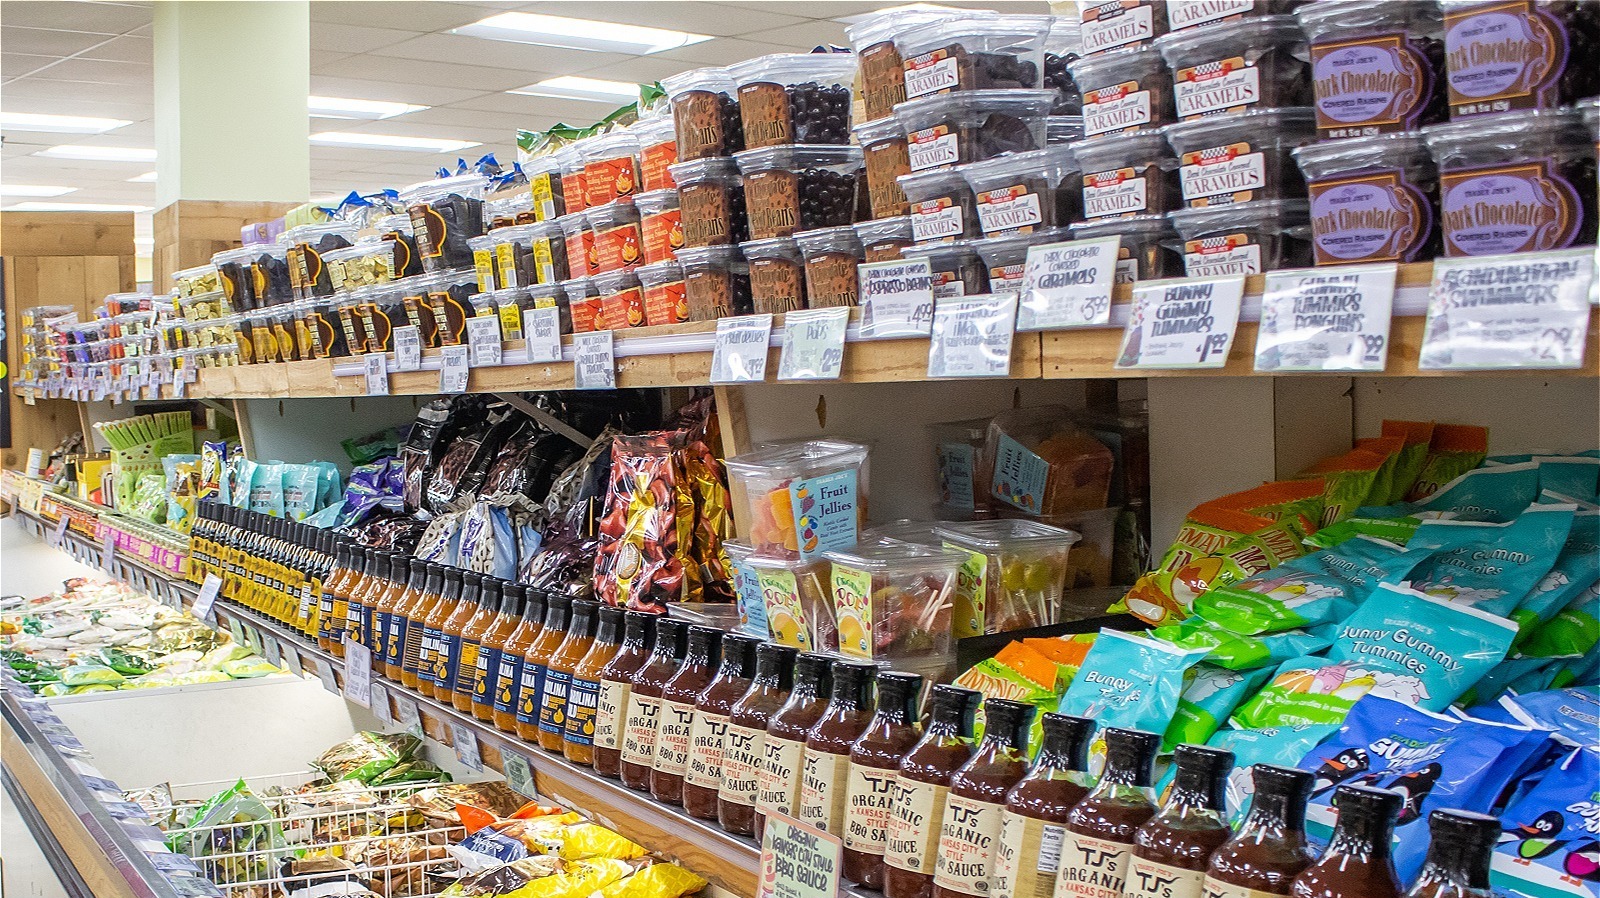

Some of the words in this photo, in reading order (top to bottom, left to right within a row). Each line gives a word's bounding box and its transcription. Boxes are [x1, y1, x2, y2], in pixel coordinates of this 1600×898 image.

[1172, 0, 1249, 25] CARAMELS
[1084, 21, 1148, 49] CARAMELS
[1470, 38, 1530, 67] Chocolate
[909, 69, 954, 95] CARAMELS
[1341, 69, 1399, 94] Chocolate
[1453, 73, 1485, 84] COVERED
[1486, 67, 1518, 76] RAISINS
[1178, 85, 1253, 113] CARAMELS
[1323, 100, 1356, 110] COVERED
[1357, 96, 1387, 106] RAISINS
[1085, 106, 1145, 133] CARAMELS
[1184, 169, 1259, 195] CARAMELS
[982, 208, 1037, 230] CARAMELS
[1339, 206, 1400, 231] Chocolate
[1475, 201, 1542, 227] Chocolate
[915, 219, 959, 238] CARAMELS
[1455, 231, 1491, 241] COVERED
[1492, 228, 1528, 238] RAISINS
[1322, 236, 1355, 246] COVERED
[1356, 233, 1385, 242] RAISINS
[1049, 259, 1080, 272] COVERED
[1038, 268, 1097, 289] CARAMELS
[1165, 284, 1214, 301] BUNNY
[1156, 300, 1212, 320] GUMMY
[1292, 293, 1362, 314] TUMMIES
[1150, 317, 1214, 337] TUMMIES
[1001, 448, 1013, 475] Fruit
[1011, 450, 1023, 482] Jellies
[820, 484, 848, 500] Fruit
[819, 502, 852, 518] Jellies
[1321, 554, 1359, 572] Bunny
[1472, 548, 1534, 566] Gummy
[1410, 622, 1436, 635] JOE'S
[1351, 641, 1427, 674] Tummies
[1392, 628, 1463, 673] Gummy
[1085, 670, 1134, 691] Bunny
[599, 701, 616, 715] ANIC
[629, 716, 658, 729] ORGA
[662, 724, 690, 736] ORGA
[631, 728, 651, 737] KANSAS
[637, 736, 653, 744] STYLE
[665, 736, 688, 744] KANSAS
[625, 738, 638, 751] BBQ
[694, 736, 723, 748] ORGA
[658, 746, 673, 761] BBQ
[698, 748, 720, 757] KANSAS
[725, 749, 762, 768] GANIC
[691, 759, 705, 774] BBQ
[705, 757, 723, 767] STYLE
[737, 763, 752, 772] CITY
[762, 761, 791, 779] ANIC
[726, 769, 740, 779] STYLE
[727, 779, 758, 792] SAUCE
[804, 775, 827, 793] ANIC
[801, 805, 824, 818] AUCE
[856, 808, 884, 818] KANSAS
[893, 804, 923, 827] ANIC
[951, 806, 978, 828] TJ's
[850, 821, 867, 839] BBQ
[866, 818, 888, 829] STYLE
[787, 825, 819, 851] ORGANIC
[943, 823, 992, 849] RGANIC
[1044, 834, 1059, 842] Facts
[942, 838, 961, 851] ANSAS
[962, 845, 979, 854] CITY
[812, 857, 833, 873] STYLE
[945, 850, 964, 862] STYLE
[1079, 848, 1118, 872] TJ's
[775, 853, 795, 882] BBQ
[797, 863, 828, 892] SAUCE
[947, 863, 986, 878] SAUCE
[1065, 882, 1096, 896] KANSAS
[1097, 887, 1118, 898] CITY
[1138, 872, 1173, 898] TJ's
